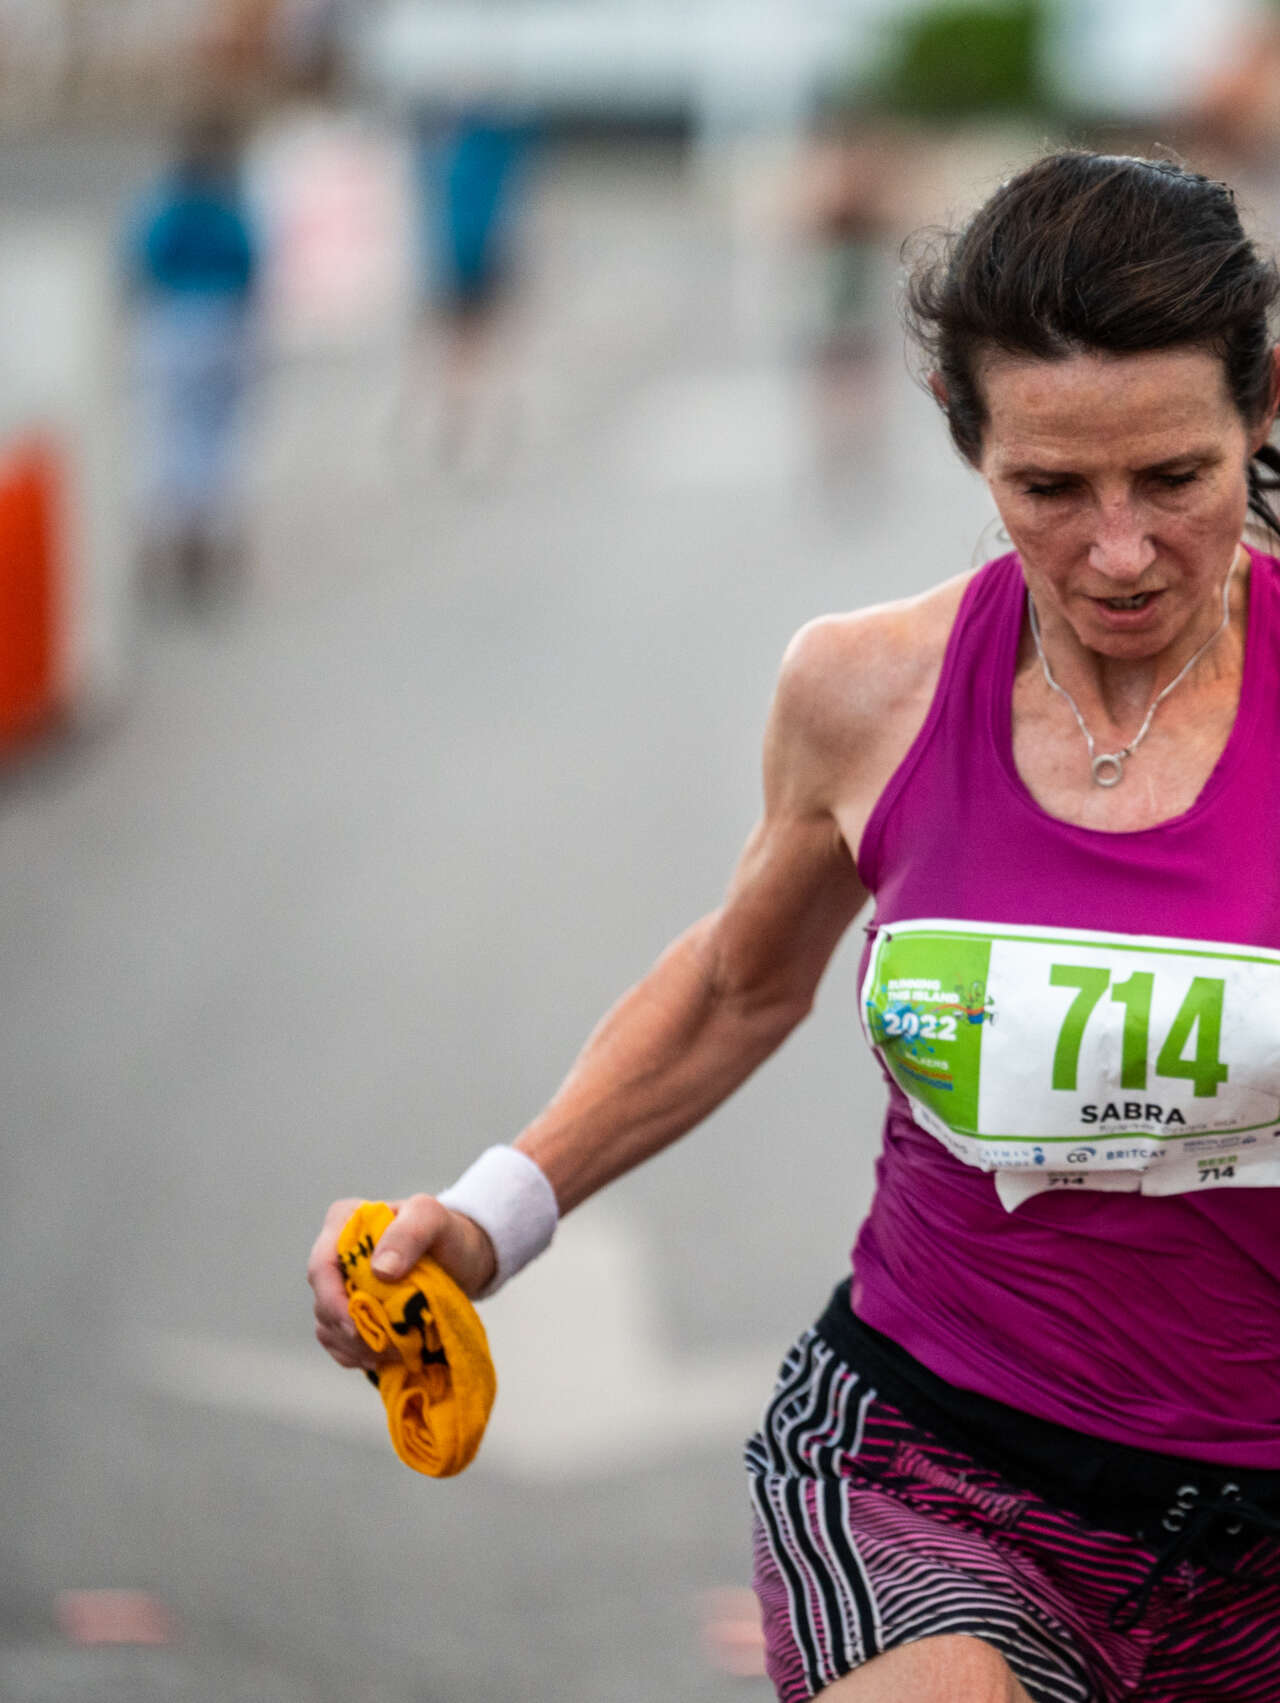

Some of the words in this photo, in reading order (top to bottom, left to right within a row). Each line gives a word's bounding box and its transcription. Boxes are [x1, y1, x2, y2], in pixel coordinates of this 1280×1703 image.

[888, 979, 941, 991] RUNNING
[911, 990, 959, 1004] ISLAND
[884, 1013, 957, 1040] 2022
[1049, 963, 1229, 1098] 714
[1081, 1102, 1186, 1124] SABRA
[1066, 1152, 1088, 1164] CG
[1106, 1148, 1167, 1160] BRITCAY
[1198, 1165, 1236, 1182] 714
